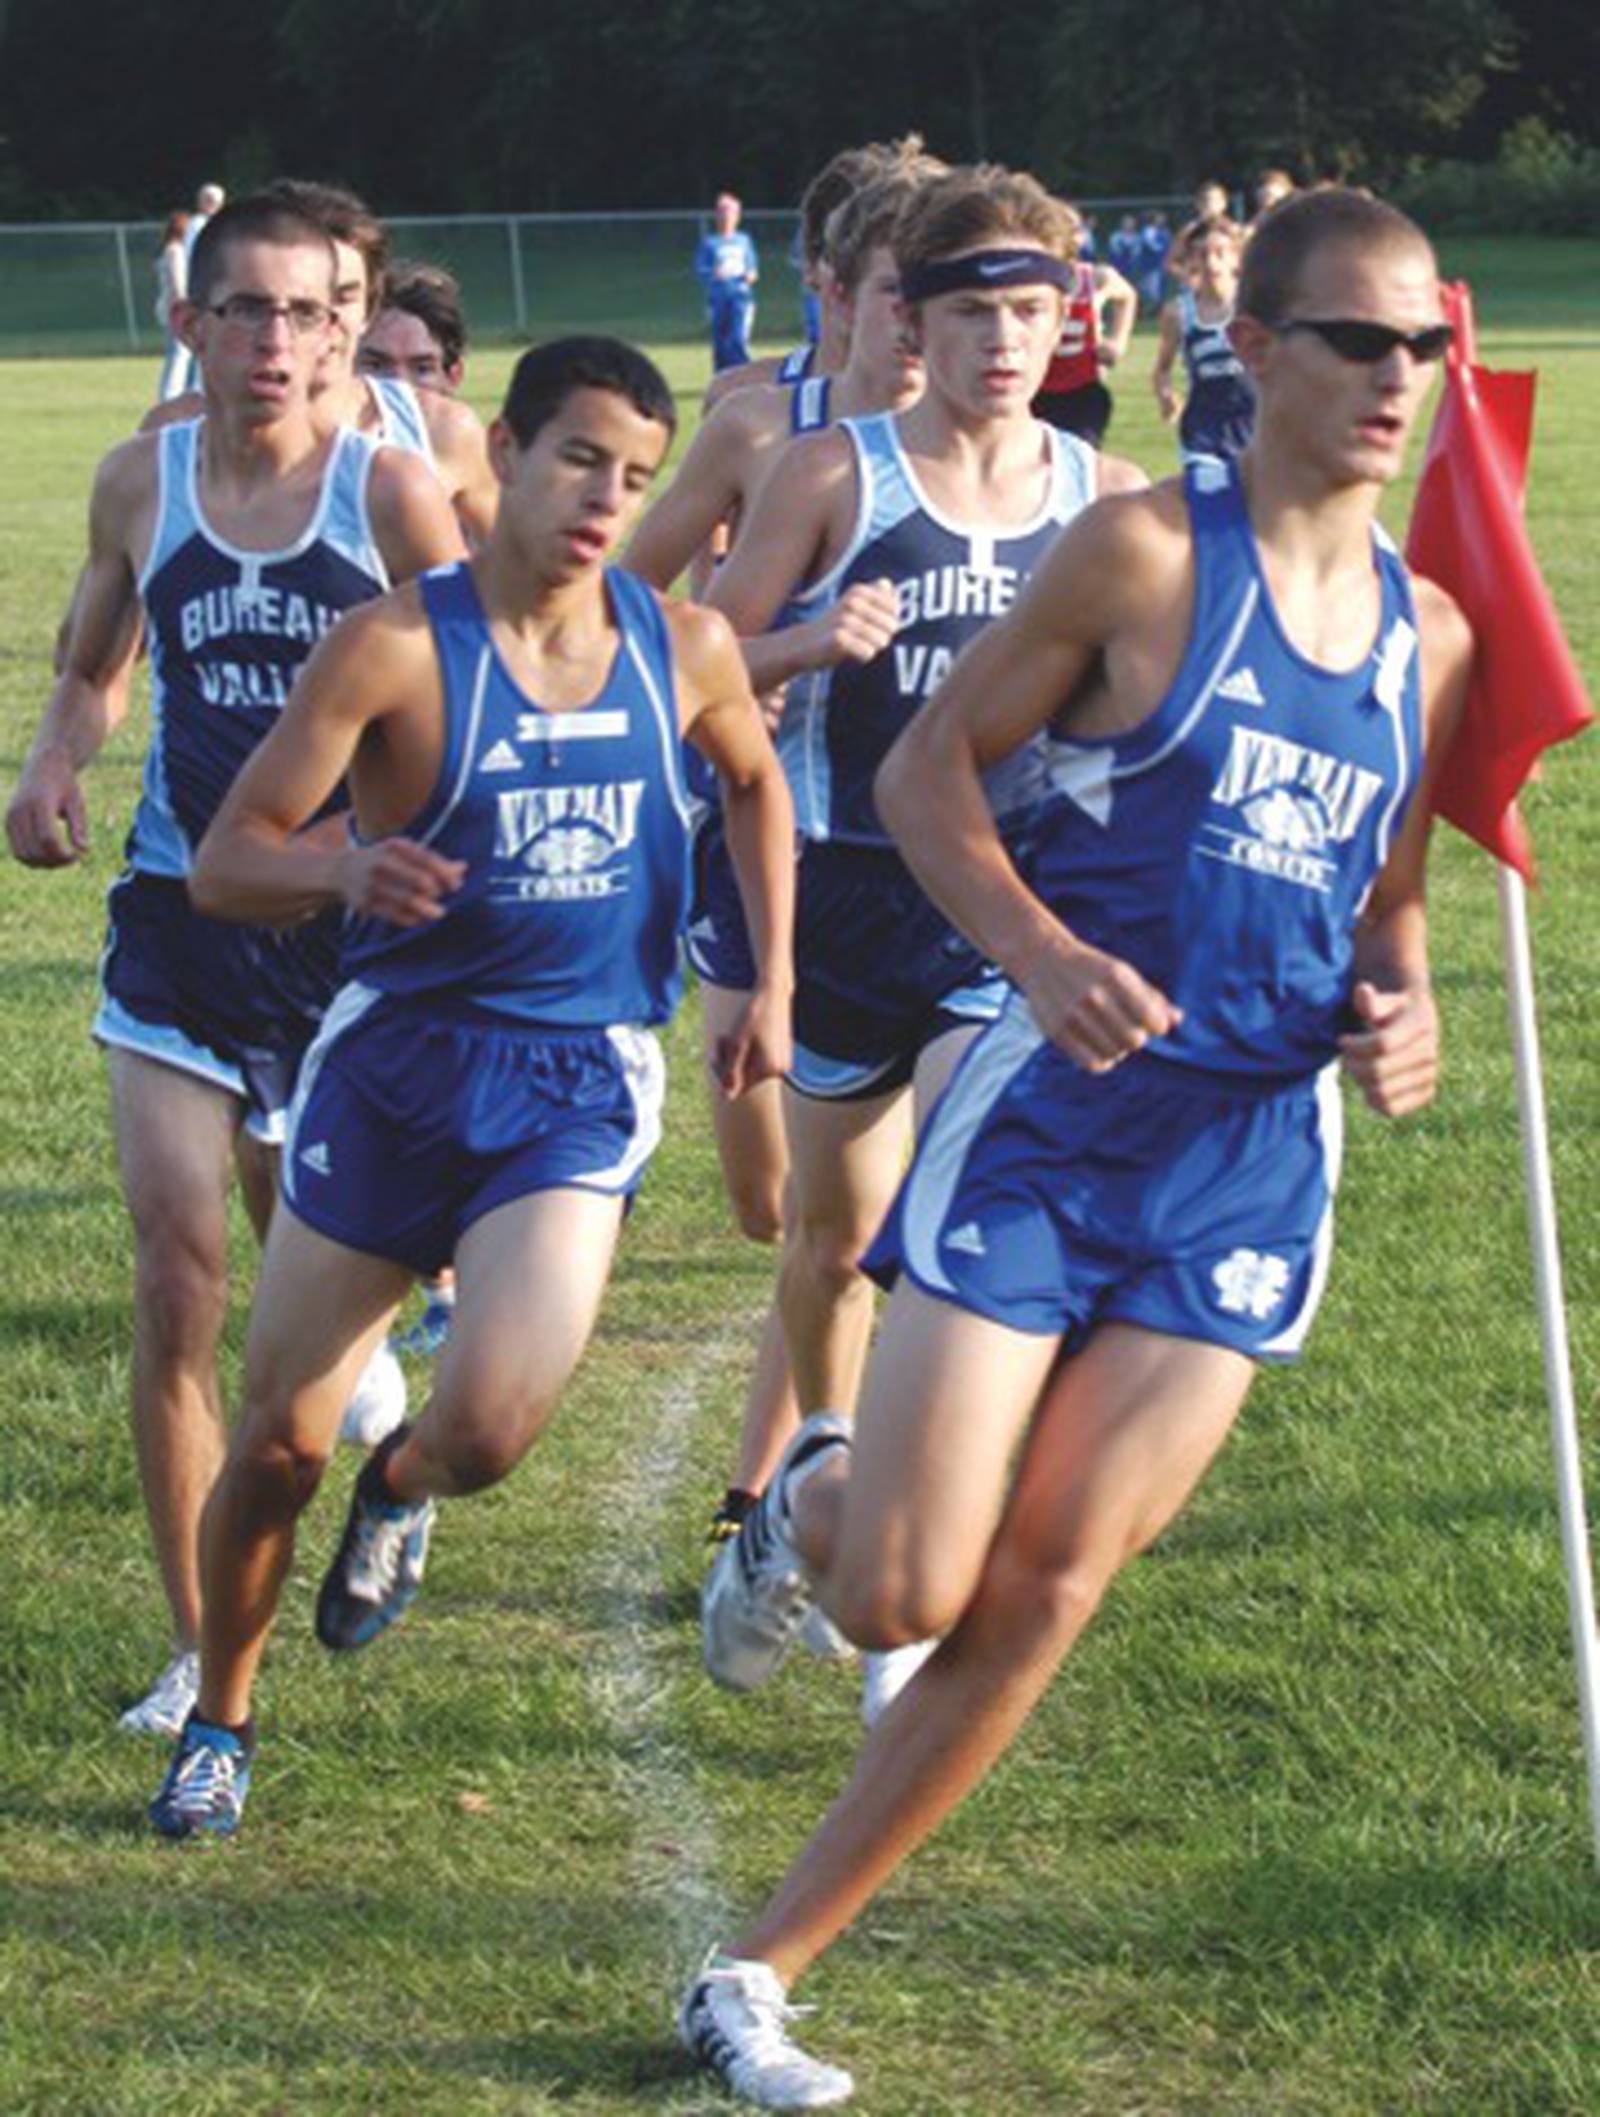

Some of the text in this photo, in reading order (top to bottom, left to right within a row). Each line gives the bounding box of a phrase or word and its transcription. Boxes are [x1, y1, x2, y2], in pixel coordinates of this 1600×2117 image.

[896, 565, 1032, 629] BURE
[194, 661, 302, 707] VALL
[494, 779, 645, 859] NEWMAN
[1210, 723, 1384, 843] NEWMAN
